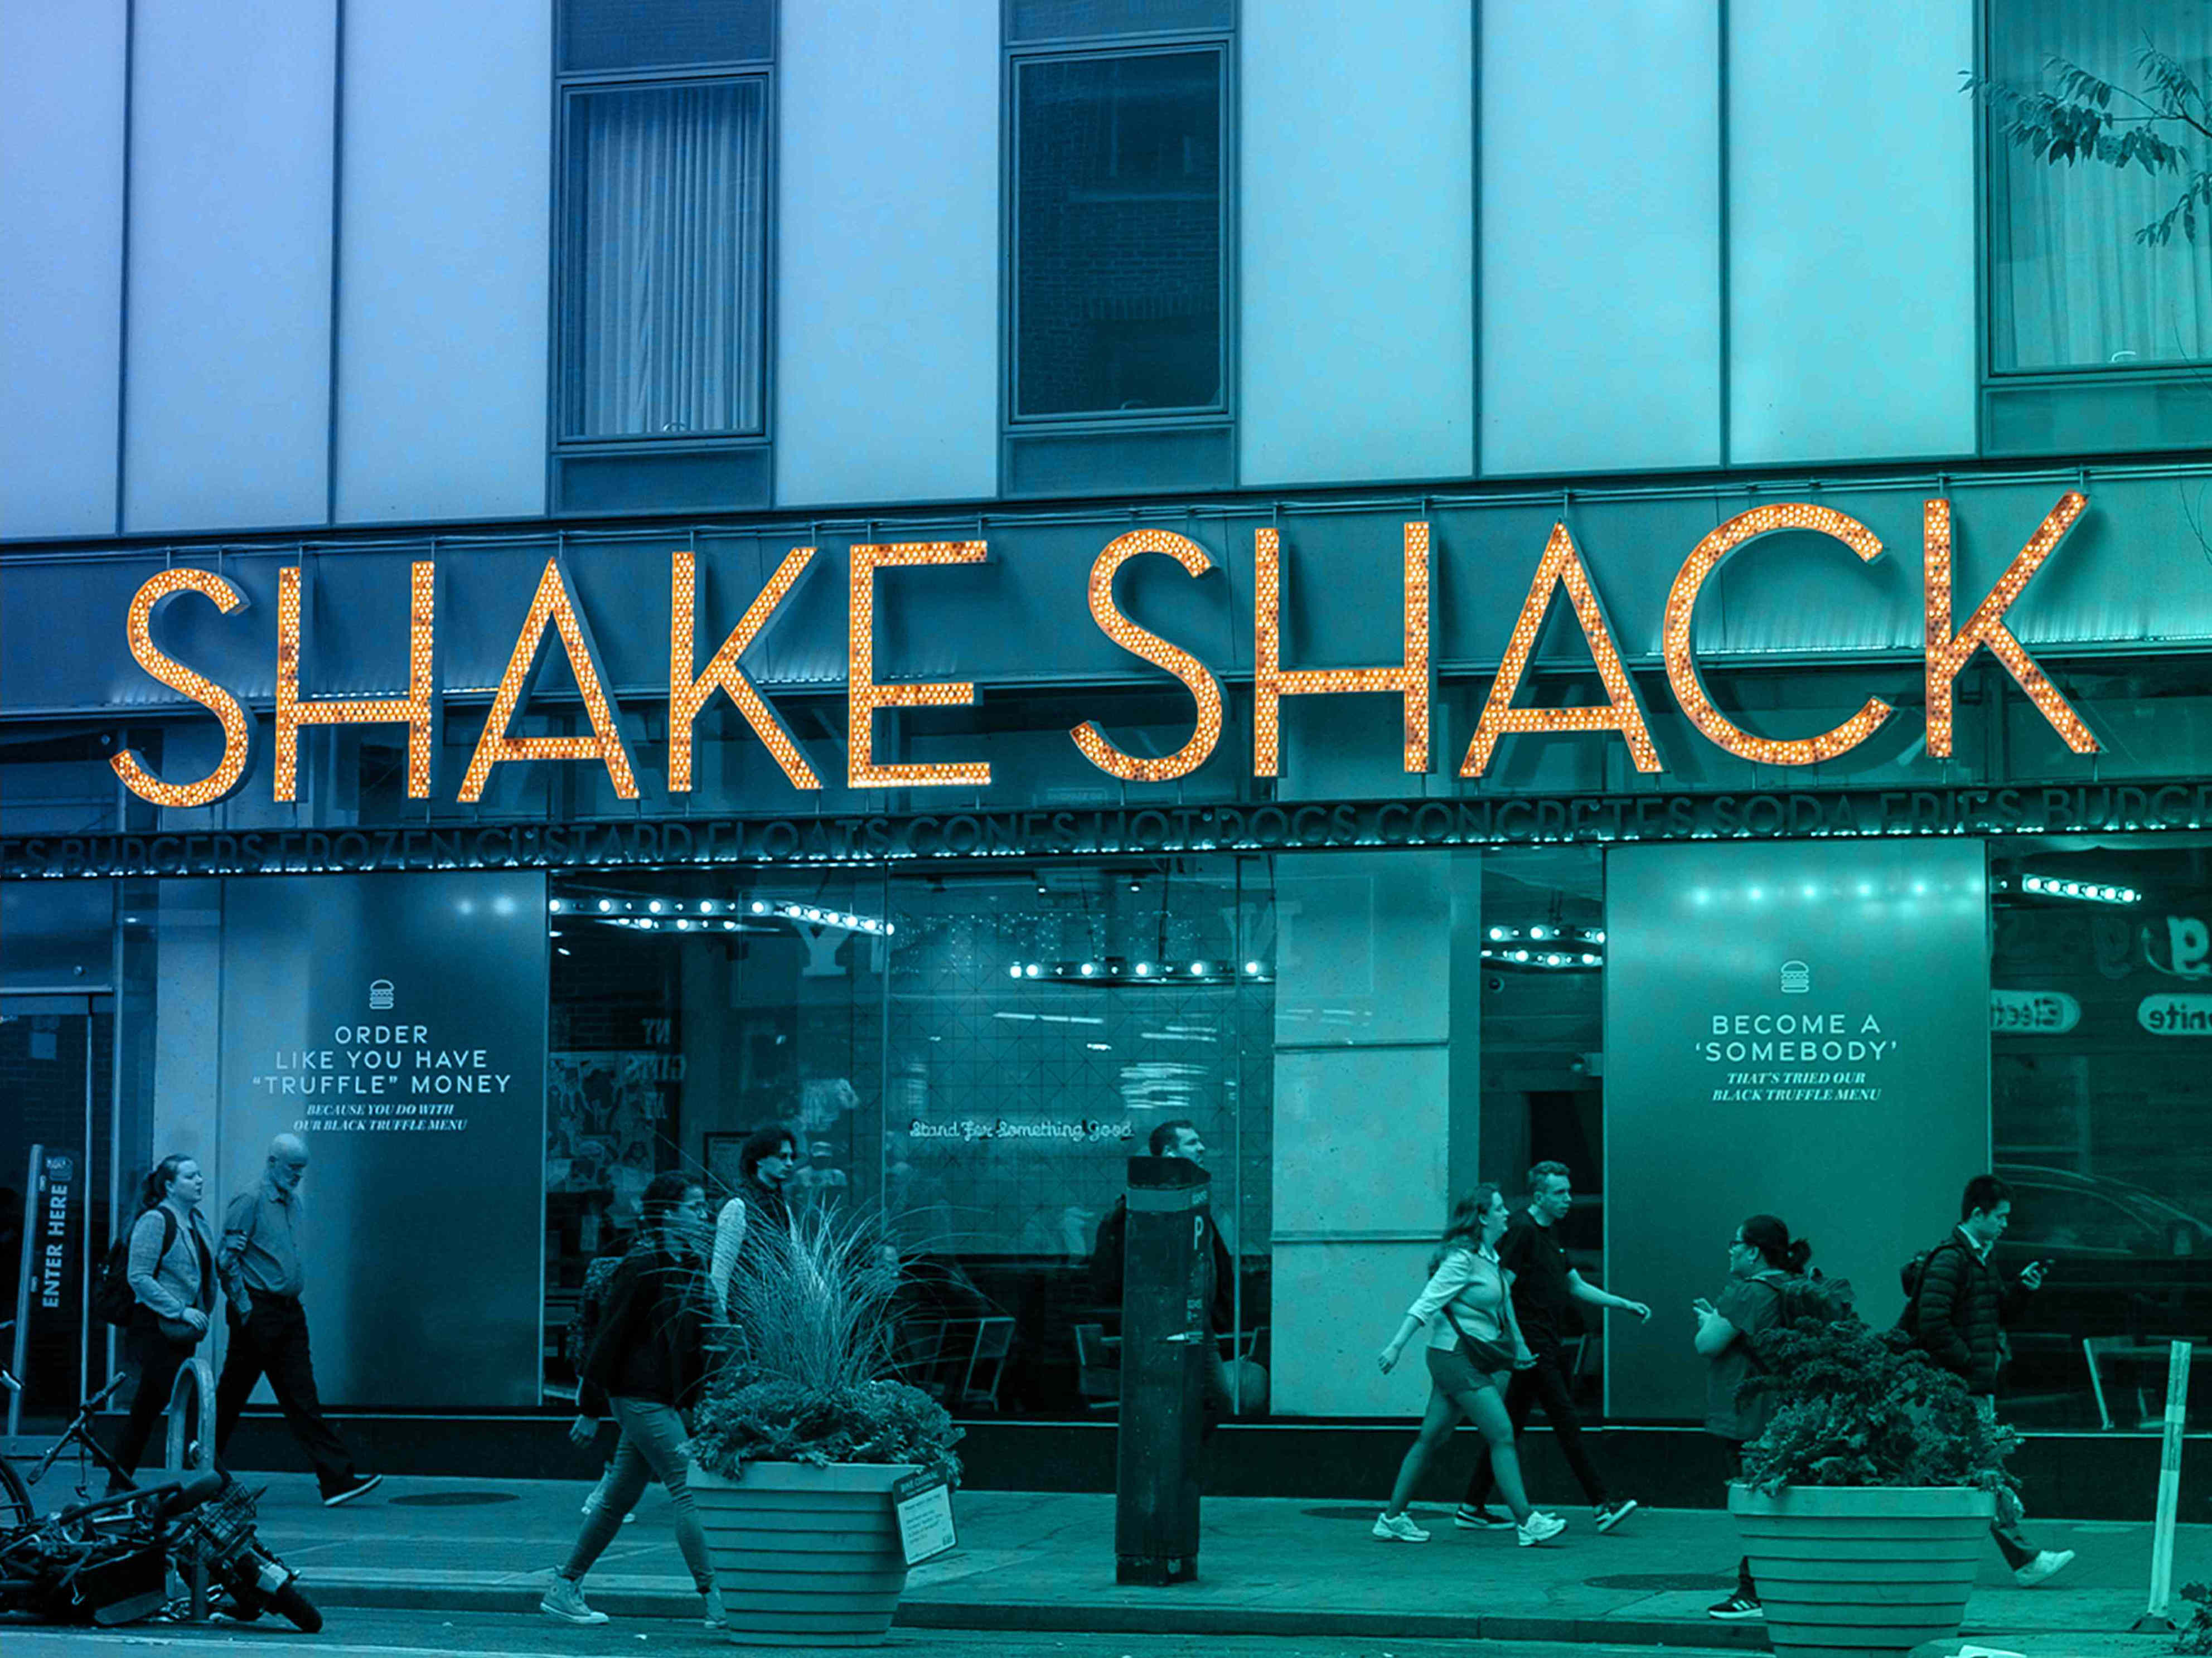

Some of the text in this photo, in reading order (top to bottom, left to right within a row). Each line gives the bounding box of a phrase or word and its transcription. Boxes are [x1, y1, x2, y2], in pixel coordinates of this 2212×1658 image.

[111, 492, 2096, 806] SHAKE SHACK
[61, 834, 263, 873] BURGERS
[280, 830, 461, 868] FROZEN
[477, 822, 694, 865] CUSTARD
[708, 818, 889, 859] FLOATS
[907, 811, 1076, 853] CONES
[1094, 810, 1201, 847] HOT
[1215, 804, 1356, 842] DOGS
[1376, 797, 1693, 840] CONCRETES
[1712, 793, 1853, 832] SODA
[1880, 789, 2022, 828] FRIES
[334, 1025, 428, 1044] ORDER
[1712, 1014, 1881, 1035] BECOME A
[276, 1049, 487, 1069] LIKE YOU HAVE
[1696, 1040, 1897, 1062] ‘SOMEBODY’
[253, 1074, 511, 1094] “TRUFFLE” MONEY
[1727, 1072, 1866, 1084] THAT’S TRIED OUR
[1712, 1088, 1881, 1102] BLACK TRUFFLE MENU
[306, 1103, 455, 1116] BECAUSE YOU DO WITH
[293, 1118, 468, 1131] OUR BLACK TRUFFLE MENU
[910, 1120, 1134, 1142] Stand For Something Good
[47, 1184, 68, 1237] HERE
[1193, 1215, 1204, 1250] P
[42, 1243, 63, 1308] ENTER
